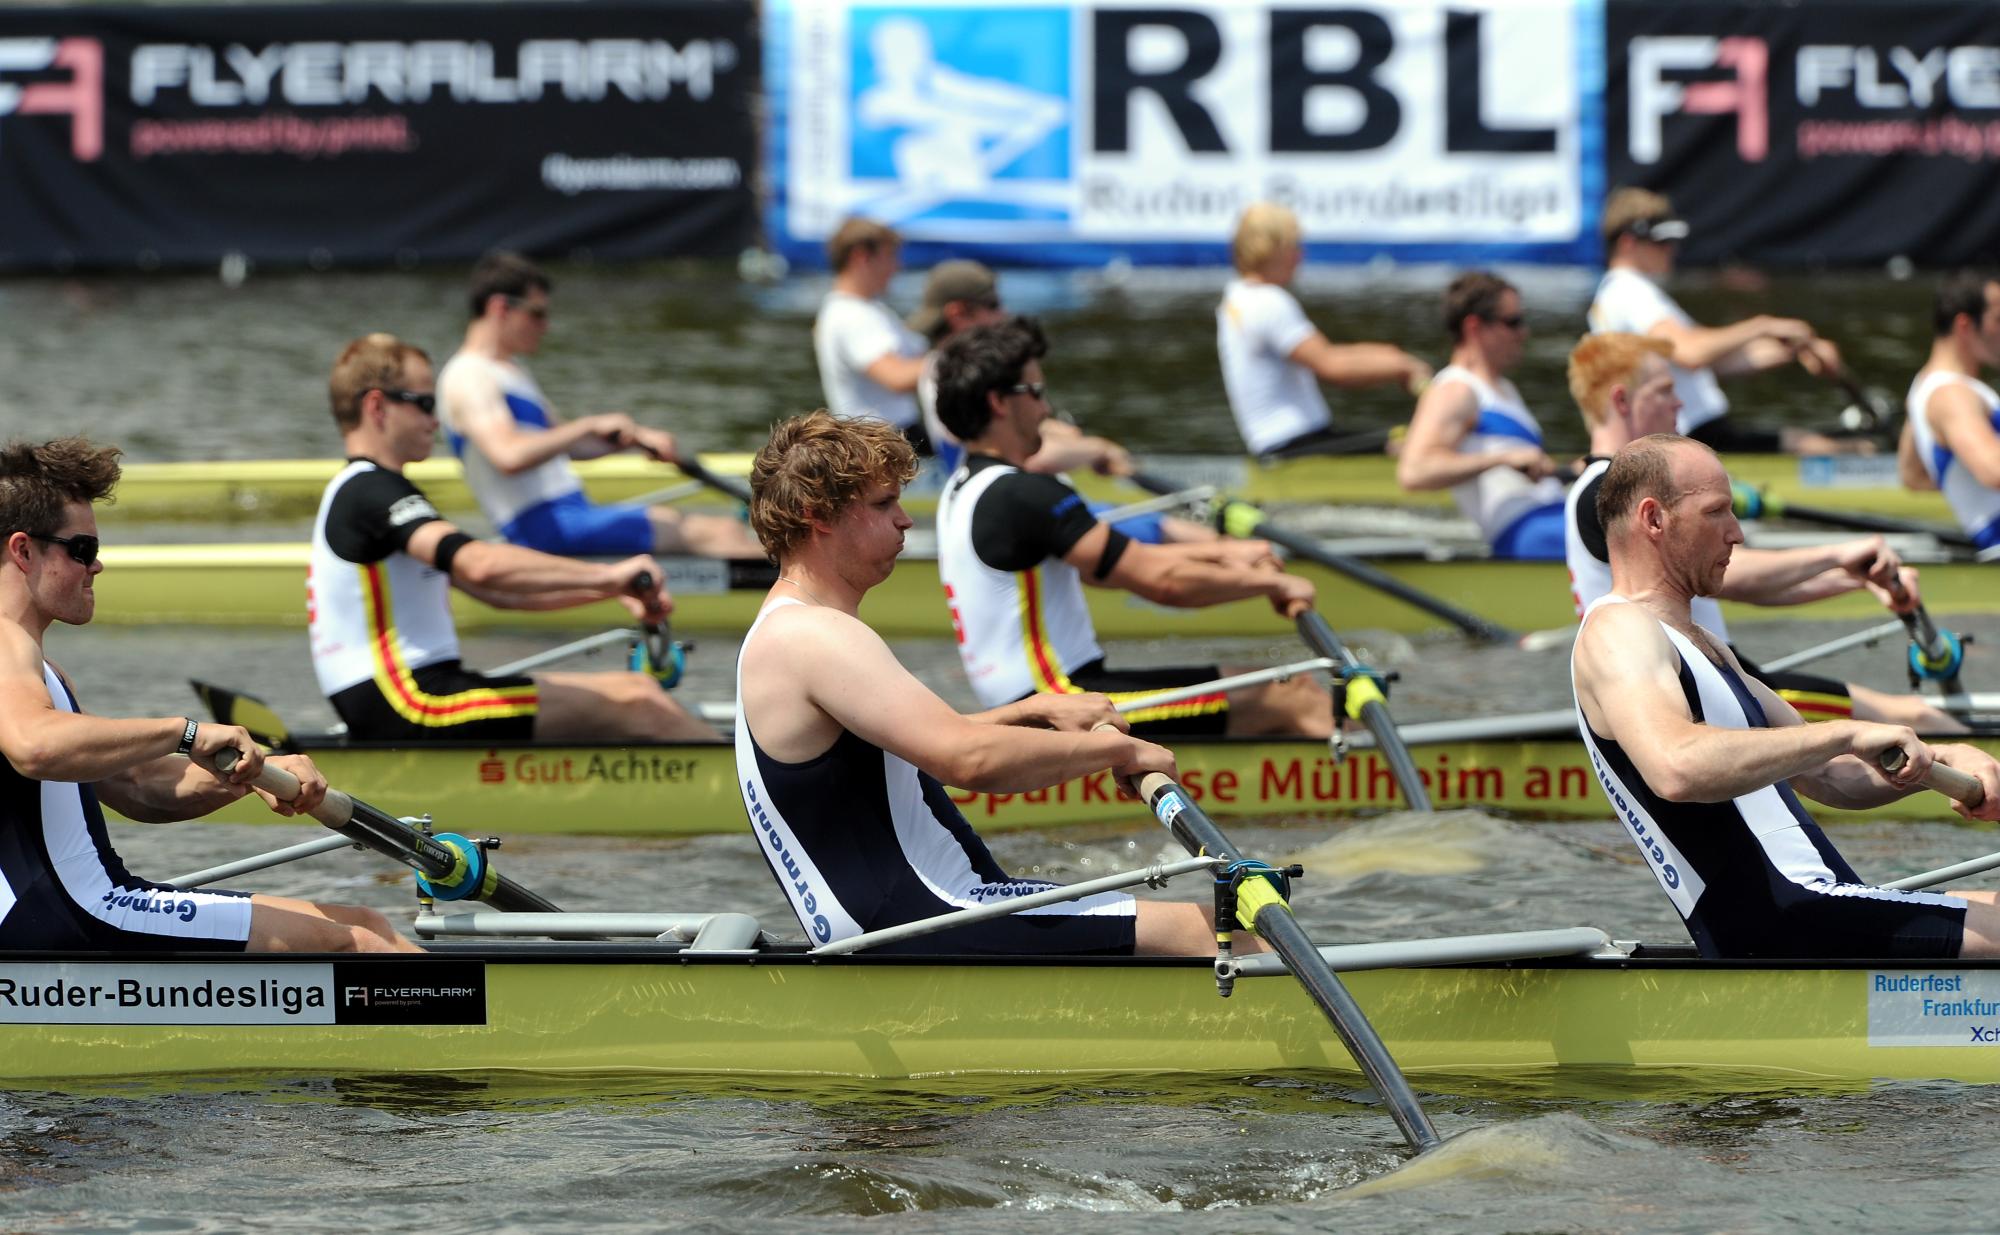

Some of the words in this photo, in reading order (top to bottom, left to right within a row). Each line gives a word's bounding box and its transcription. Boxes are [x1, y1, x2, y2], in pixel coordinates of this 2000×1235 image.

[1094, 9, 1557, 152] RBL
[1262, 753, 1504, 801] Mülhim
[1525, 765, 1588, 799] an
[1593, 750, 1680, 890] Germania
[746, 780, 831, 944] Germania
[102, 891, 197, 922] Germnia
[0, 978, 325, 1014] Ruder-Bundesliga
[1874, 974, 1962, 992] Ruderfest
